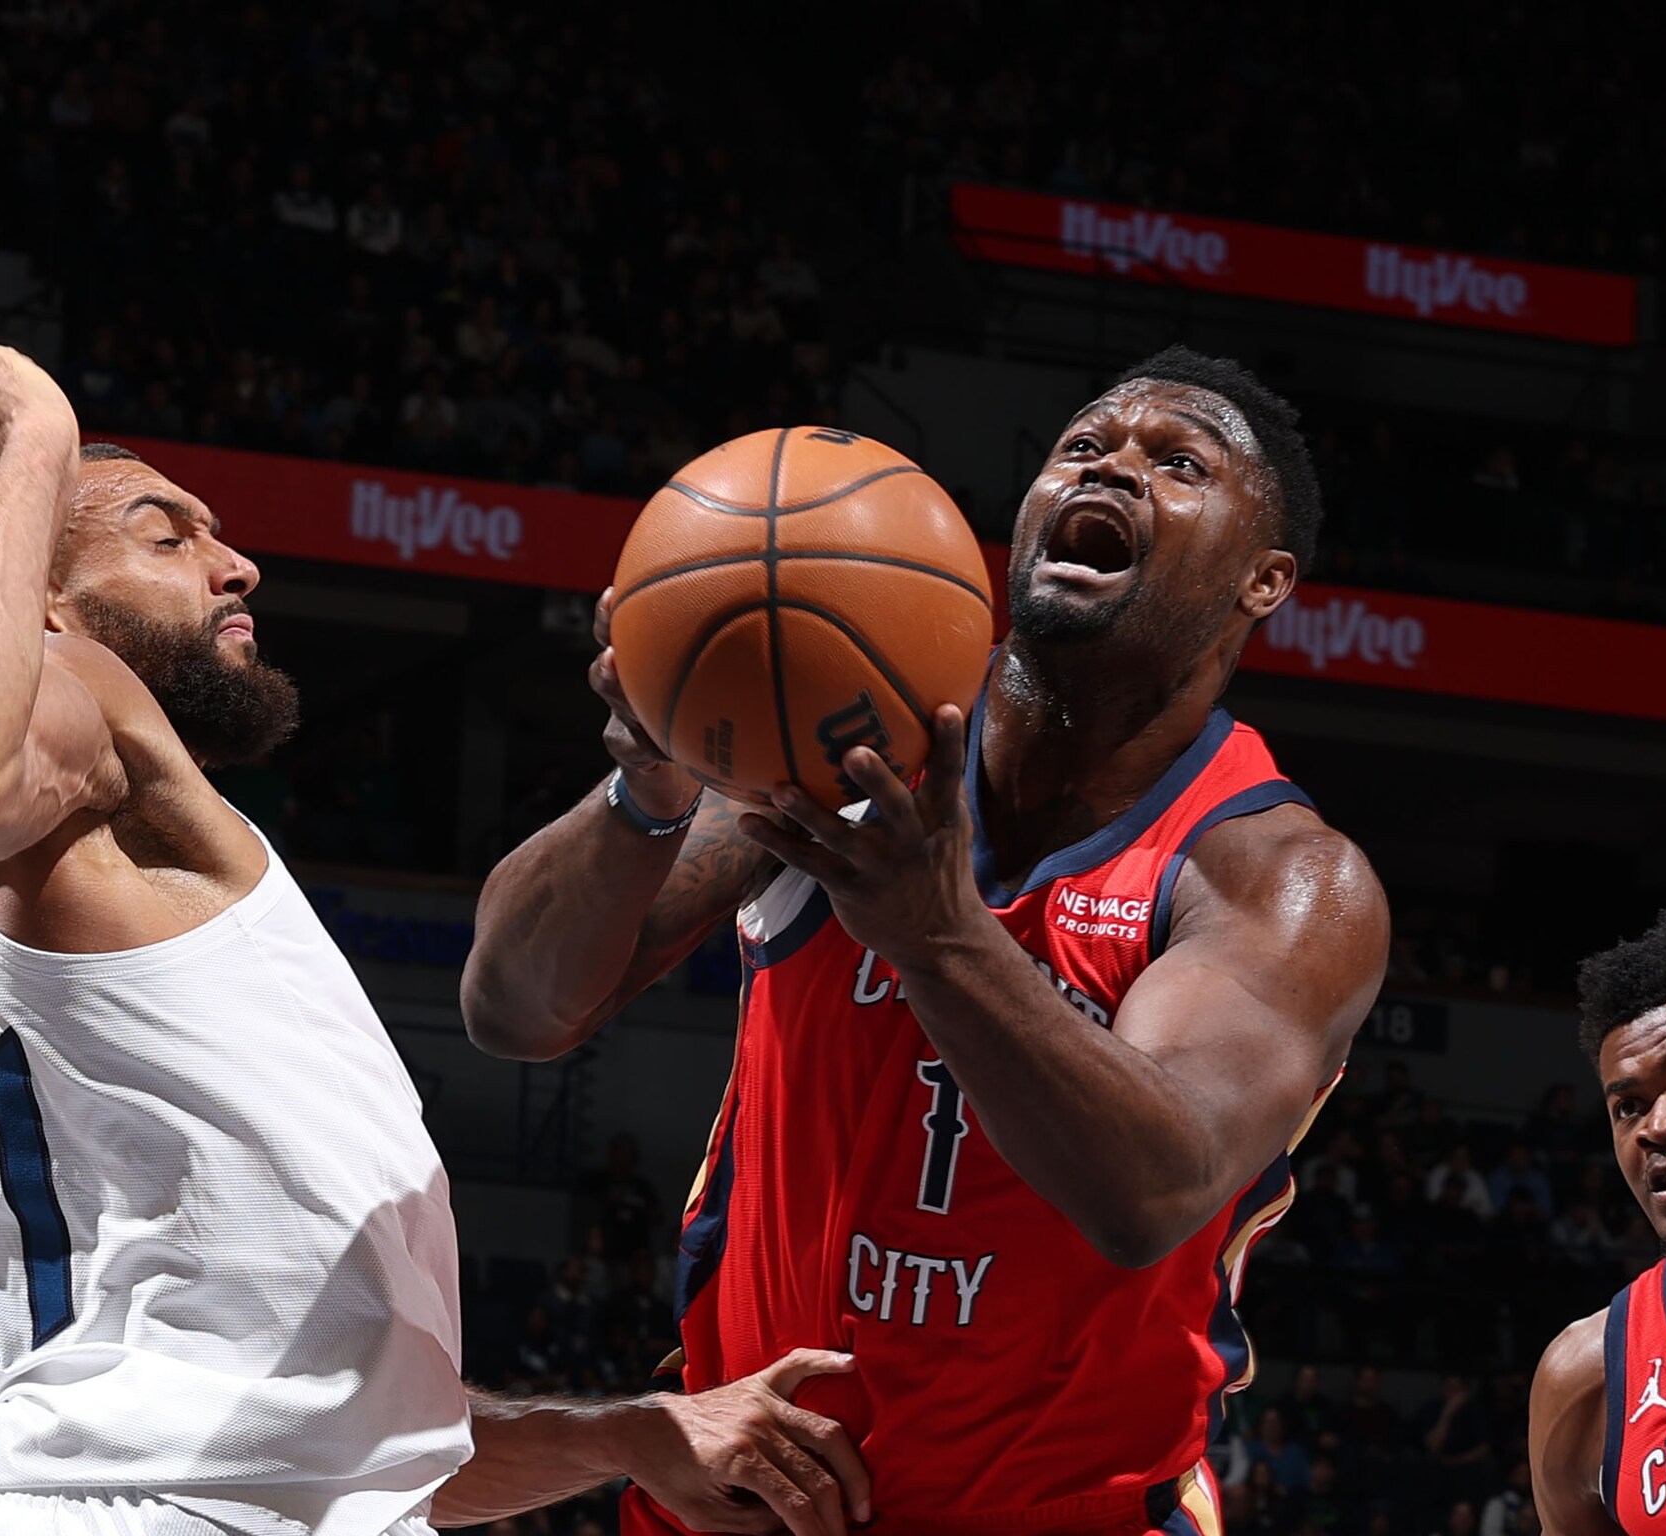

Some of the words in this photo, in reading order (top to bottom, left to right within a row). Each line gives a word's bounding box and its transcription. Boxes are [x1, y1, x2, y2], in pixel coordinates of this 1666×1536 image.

[1056, 914, 1137, 939] PRODUCTS
[1372, 1004, 1414, 1044] 18
[916, 1057, 968, 1215] 1
[847, 1233, 995, 1326] CITY
